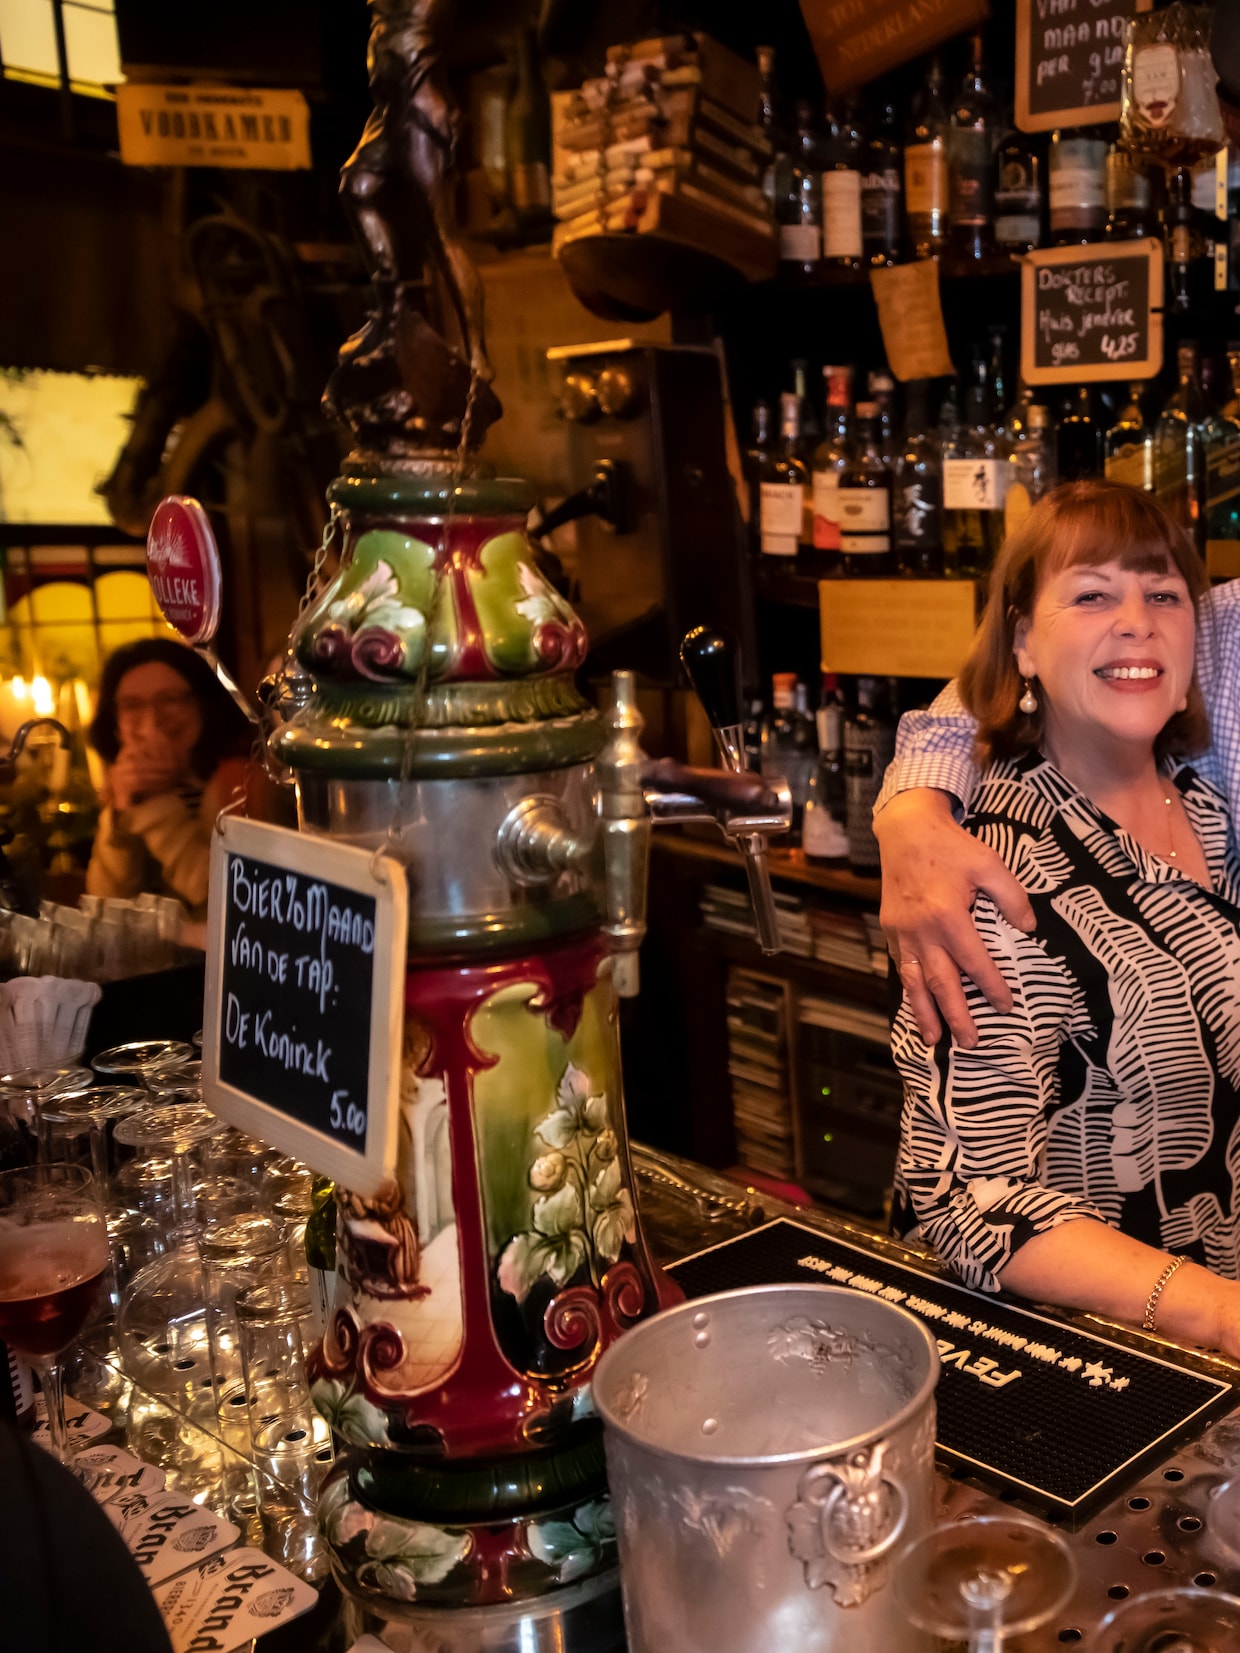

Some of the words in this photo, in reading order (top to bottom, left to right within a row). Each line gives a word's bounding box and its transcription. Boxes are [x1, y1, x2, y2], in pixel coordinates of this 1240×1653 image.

[1037, 54, 1070, 86] PER
[153, 575, 200, 606] OLLEKE
[936, 1338, 1023, 1389] FEVE
